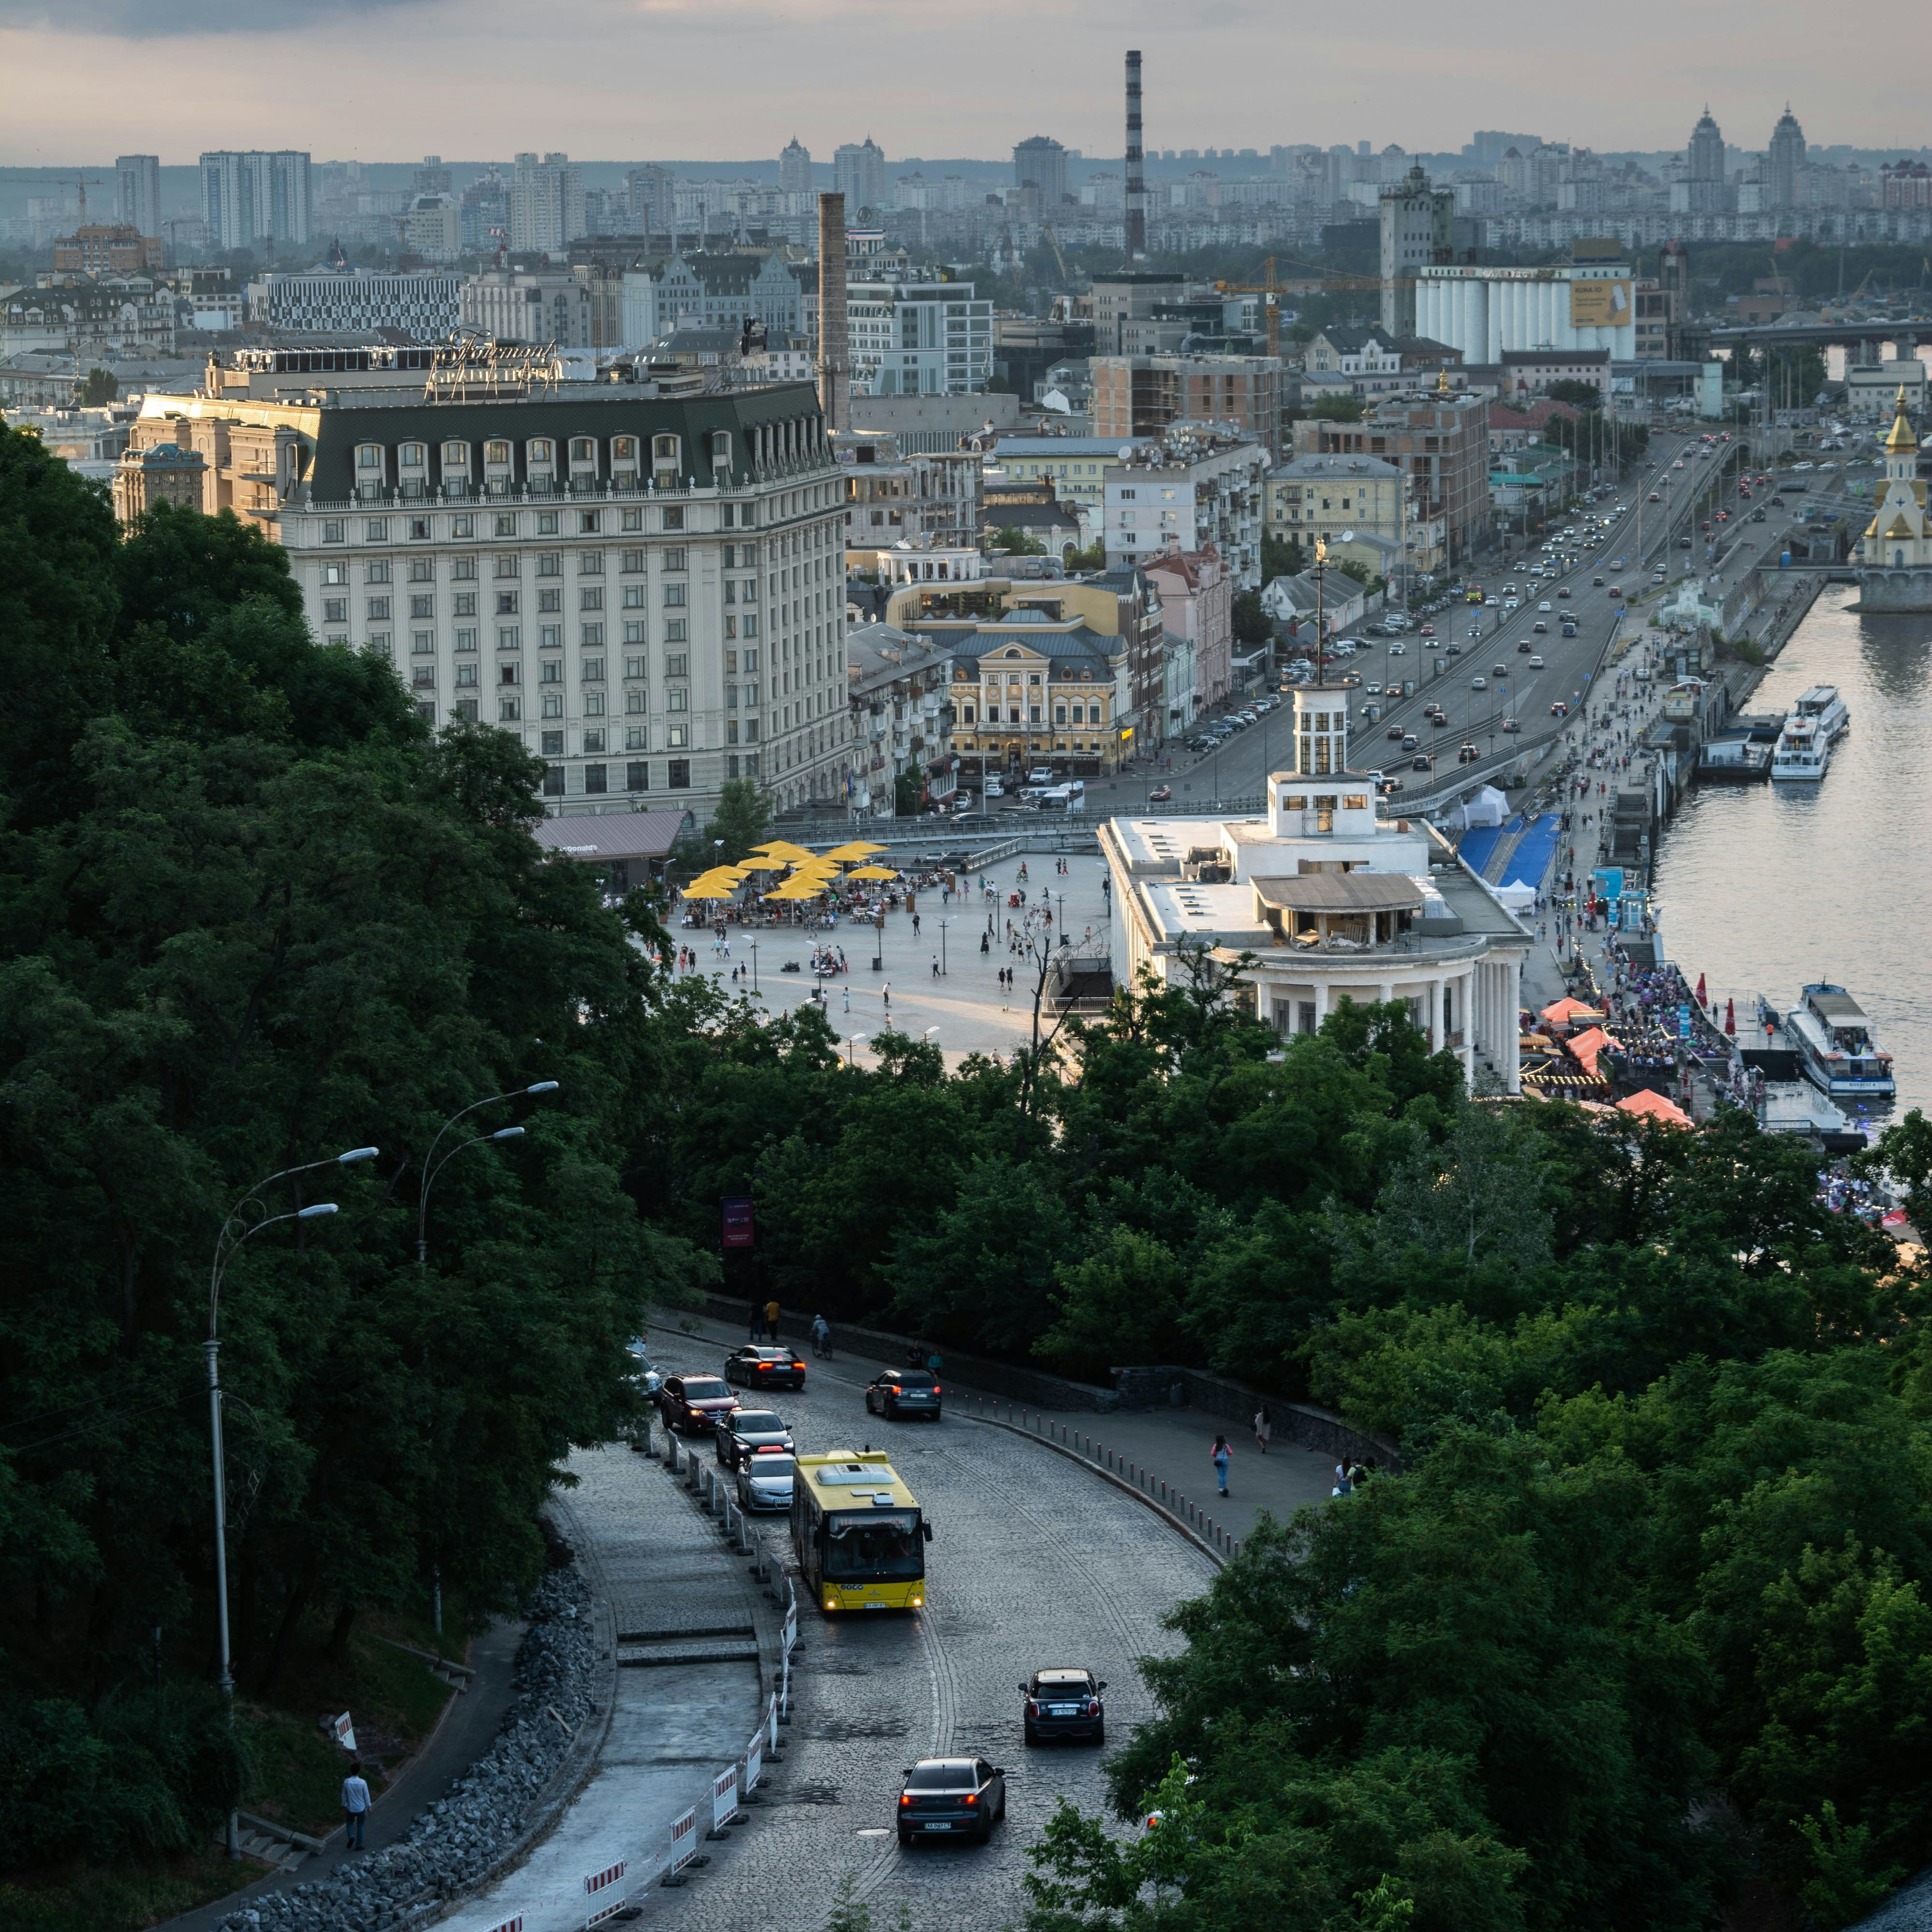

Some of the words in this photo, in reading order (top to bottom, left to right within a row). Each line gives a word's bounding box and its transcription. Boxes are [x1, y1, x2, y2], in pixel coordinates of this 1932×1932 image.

[437, 328, 556, 368] Fairmont
[432, 369, 497, 383] GRAND
[503, 369, 562, 381] HOTEL
